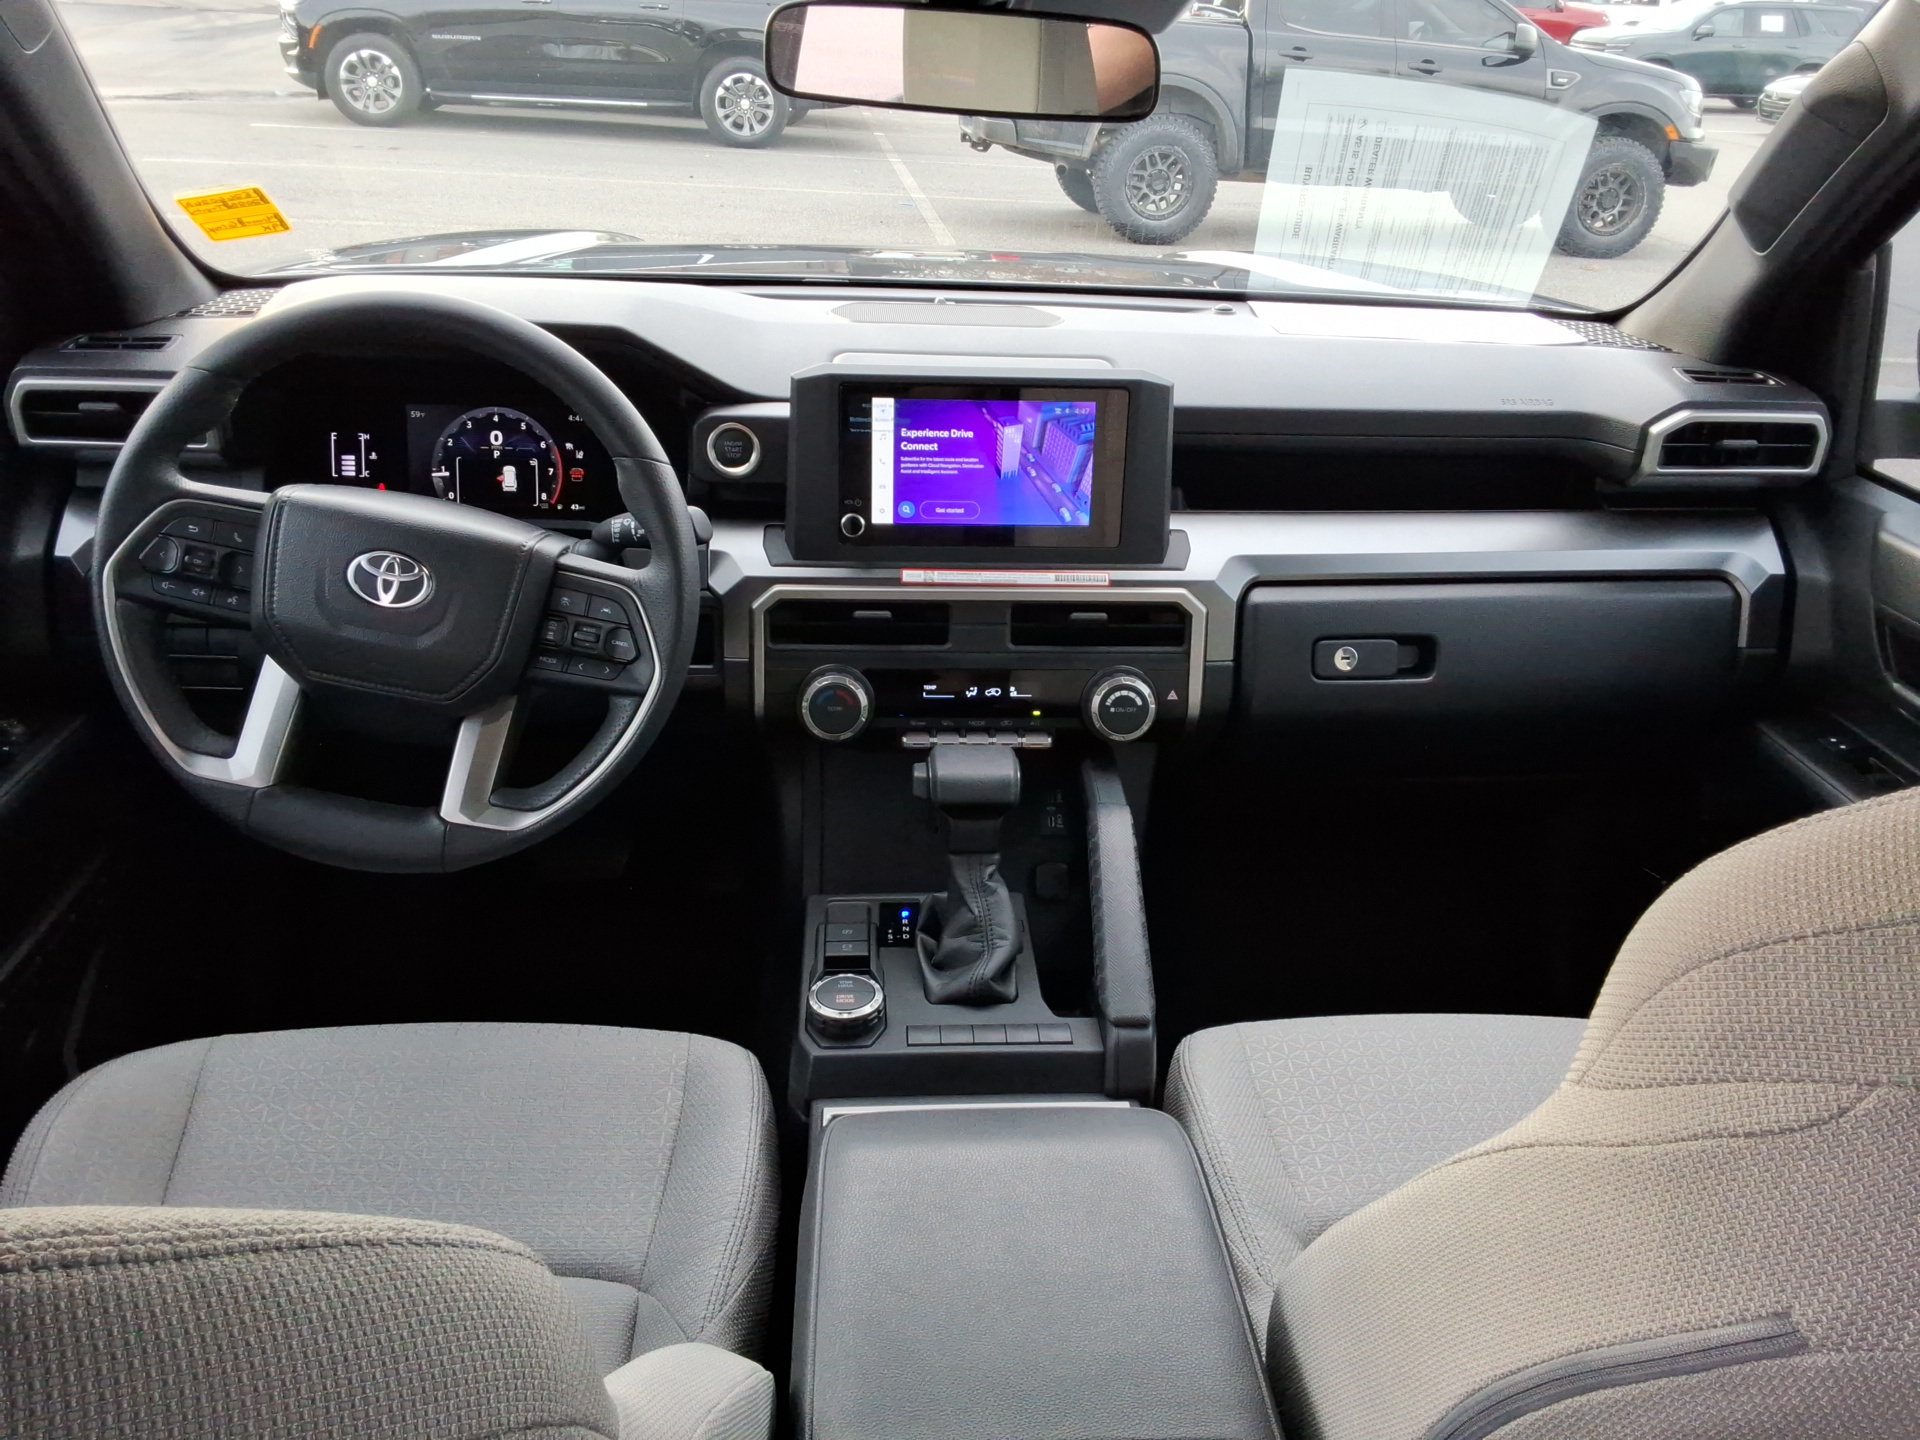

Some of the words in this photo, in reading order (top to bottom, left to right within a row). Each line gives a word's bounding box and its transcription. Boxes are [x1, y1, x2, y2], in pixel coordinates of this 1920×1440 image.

[1074, 407, 1090, 415] 4:47
[466, 421, 472, 429] 3
[521, 422, 527, 430] 5
[900, 428, 950, 439] Experience
[950, 429, 974, 438] Drive
[447, 438, 453, 446] 2
[490, 430, 503, 446] 0
[540, 441, 546, 449] 6
[900, 441, 938, 451] Connect
[493, 450, 500, 459] P
[548, 468, 554, 476] 7
[448, 491, 455, 499] 0
[541, 492, 547, 500] 8
[538, 655, 557, 664] MODE
[901, 910, 909, 918] P
